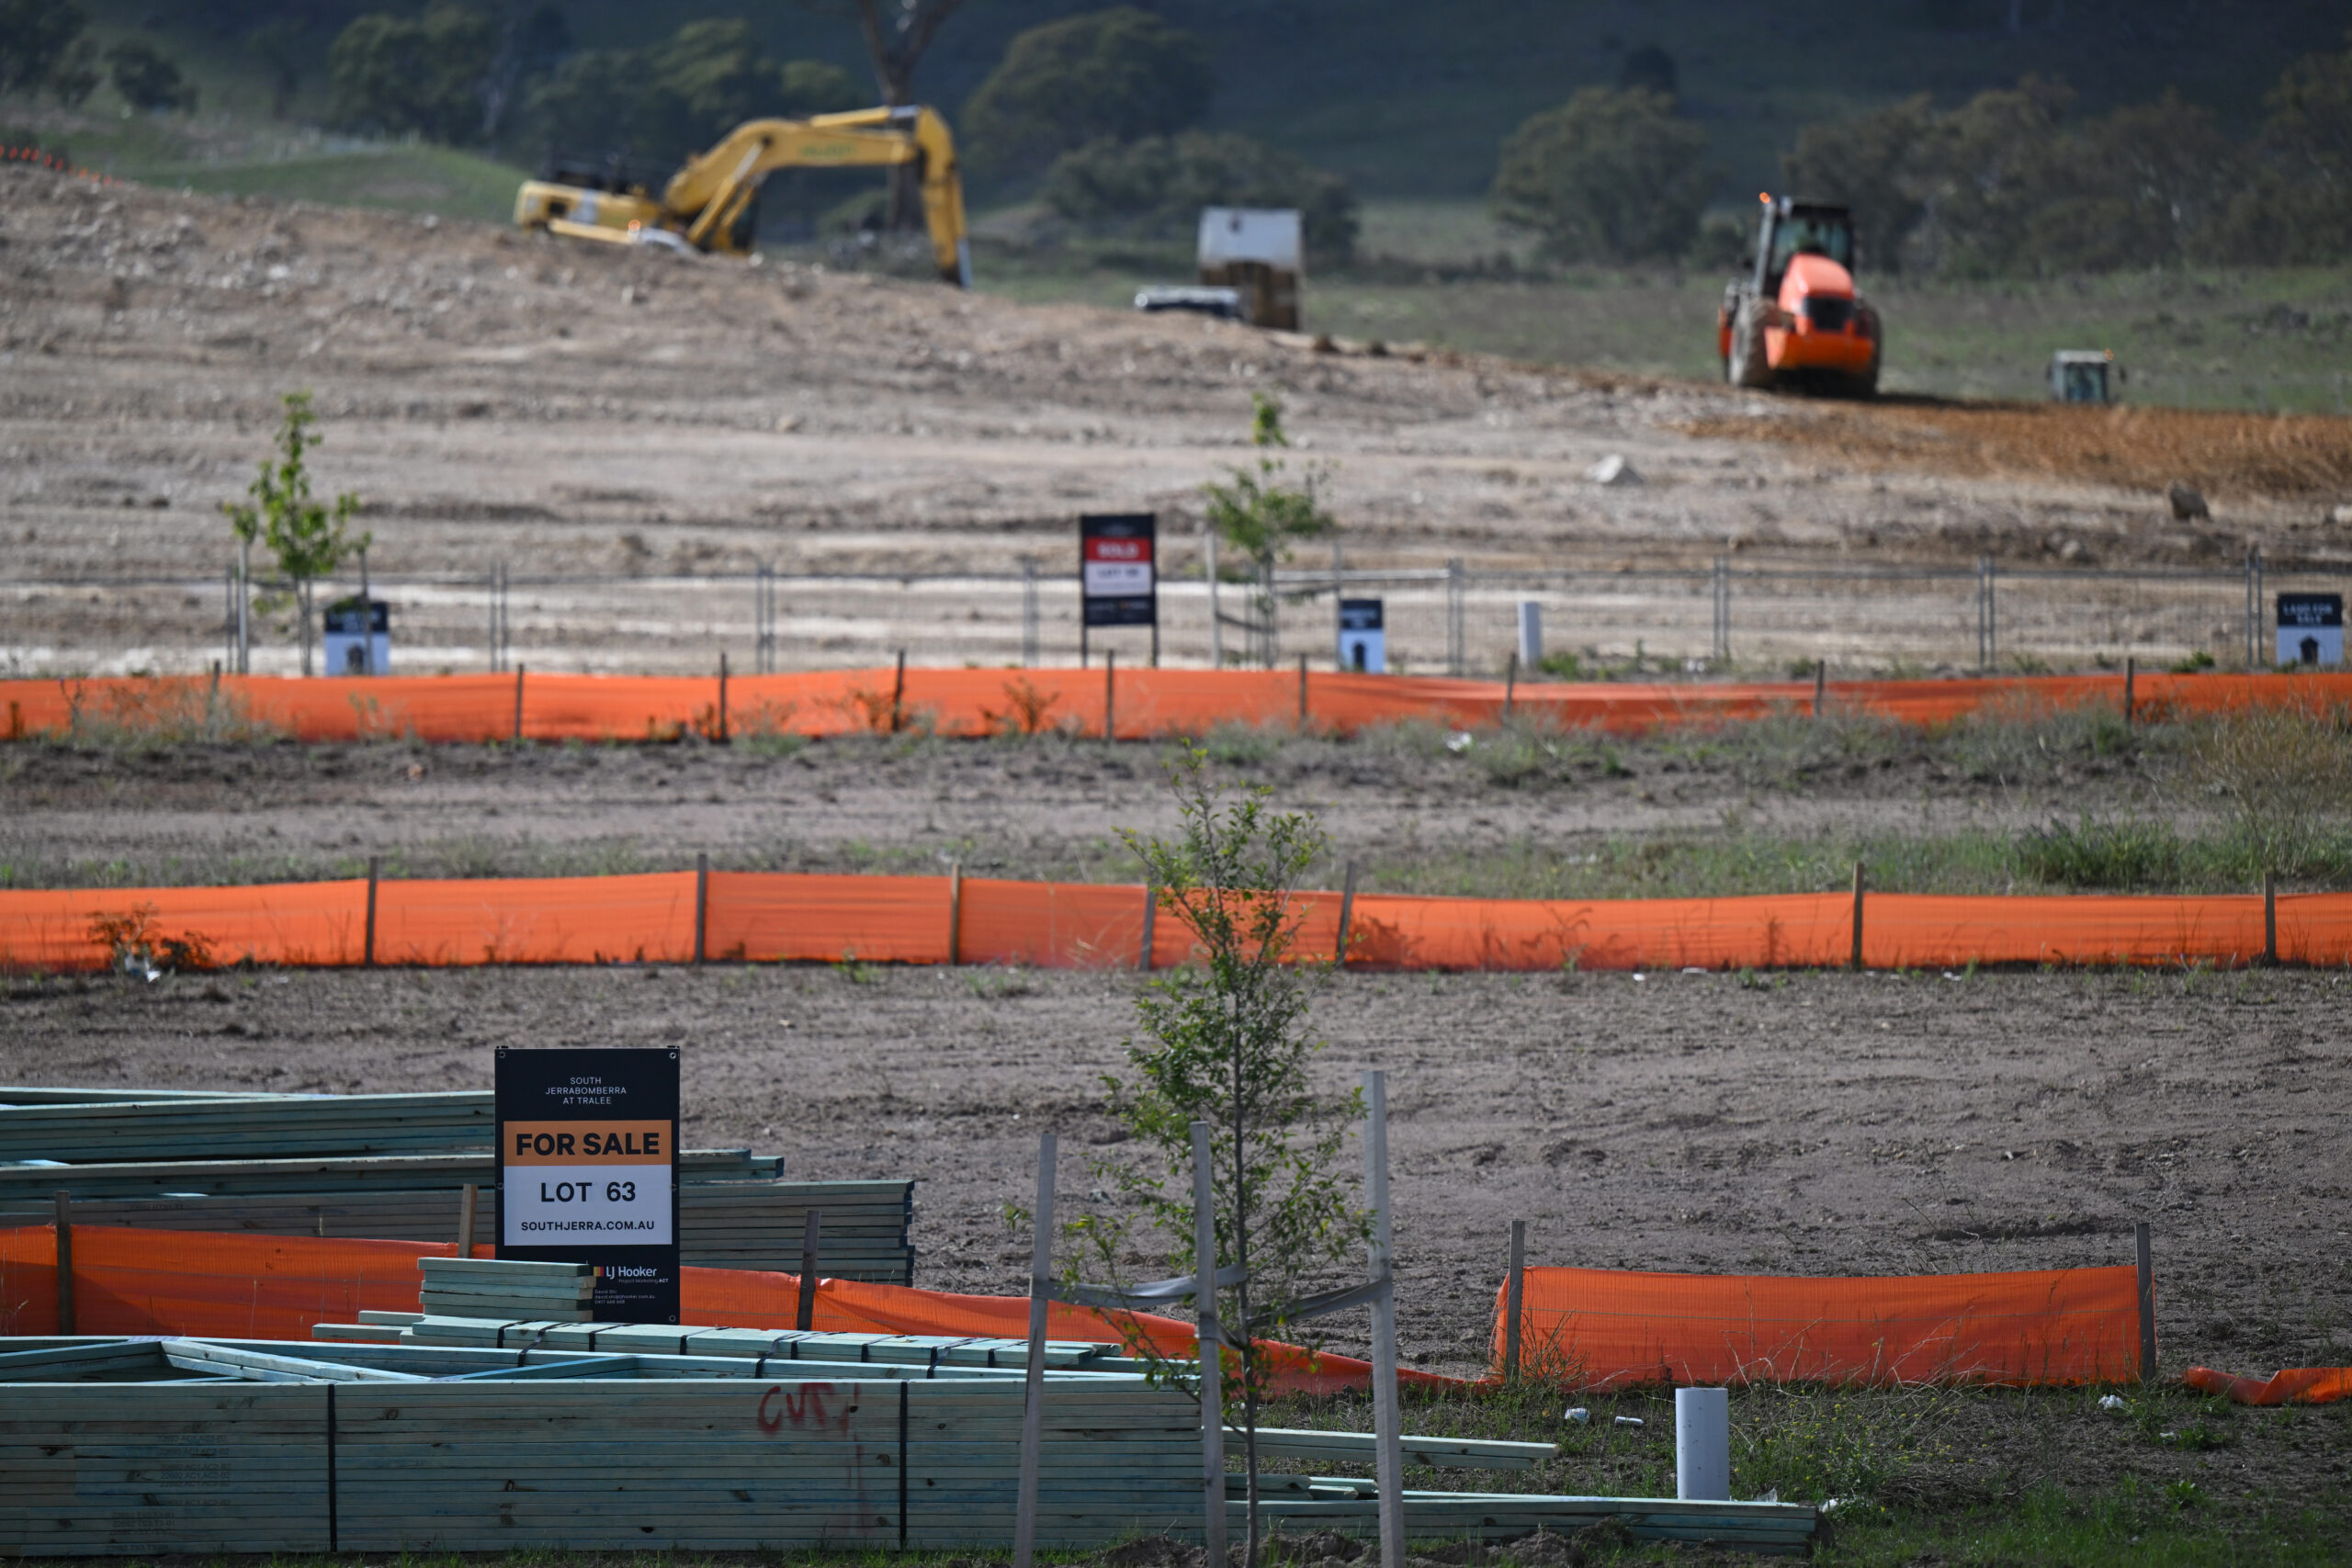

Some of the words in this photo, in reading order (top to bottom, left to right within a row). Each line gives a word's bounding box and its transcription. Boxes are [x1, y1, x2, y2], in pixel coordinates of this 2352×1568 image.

[570, 1077, 602, 1085] SOUTH
[545, 1086, 627, 1095] JERRABOMBERRA
[562, 1096, 576, 1104] AT
[578, 1096, 612, 1104] TRALEE
[516, 1134, 576, 1156] FOR
[583, 1133, 660, 1156] SALE
[540, 1182, 593, 1202] LOT
[605, 1181, 636, 1201] 63
[521, 1221, 654, 1231] SOUTHJERRA.COM.AU
[605, 1266, 615, 1280] LJ
[617, 1266, 657, 1277] Hooker
